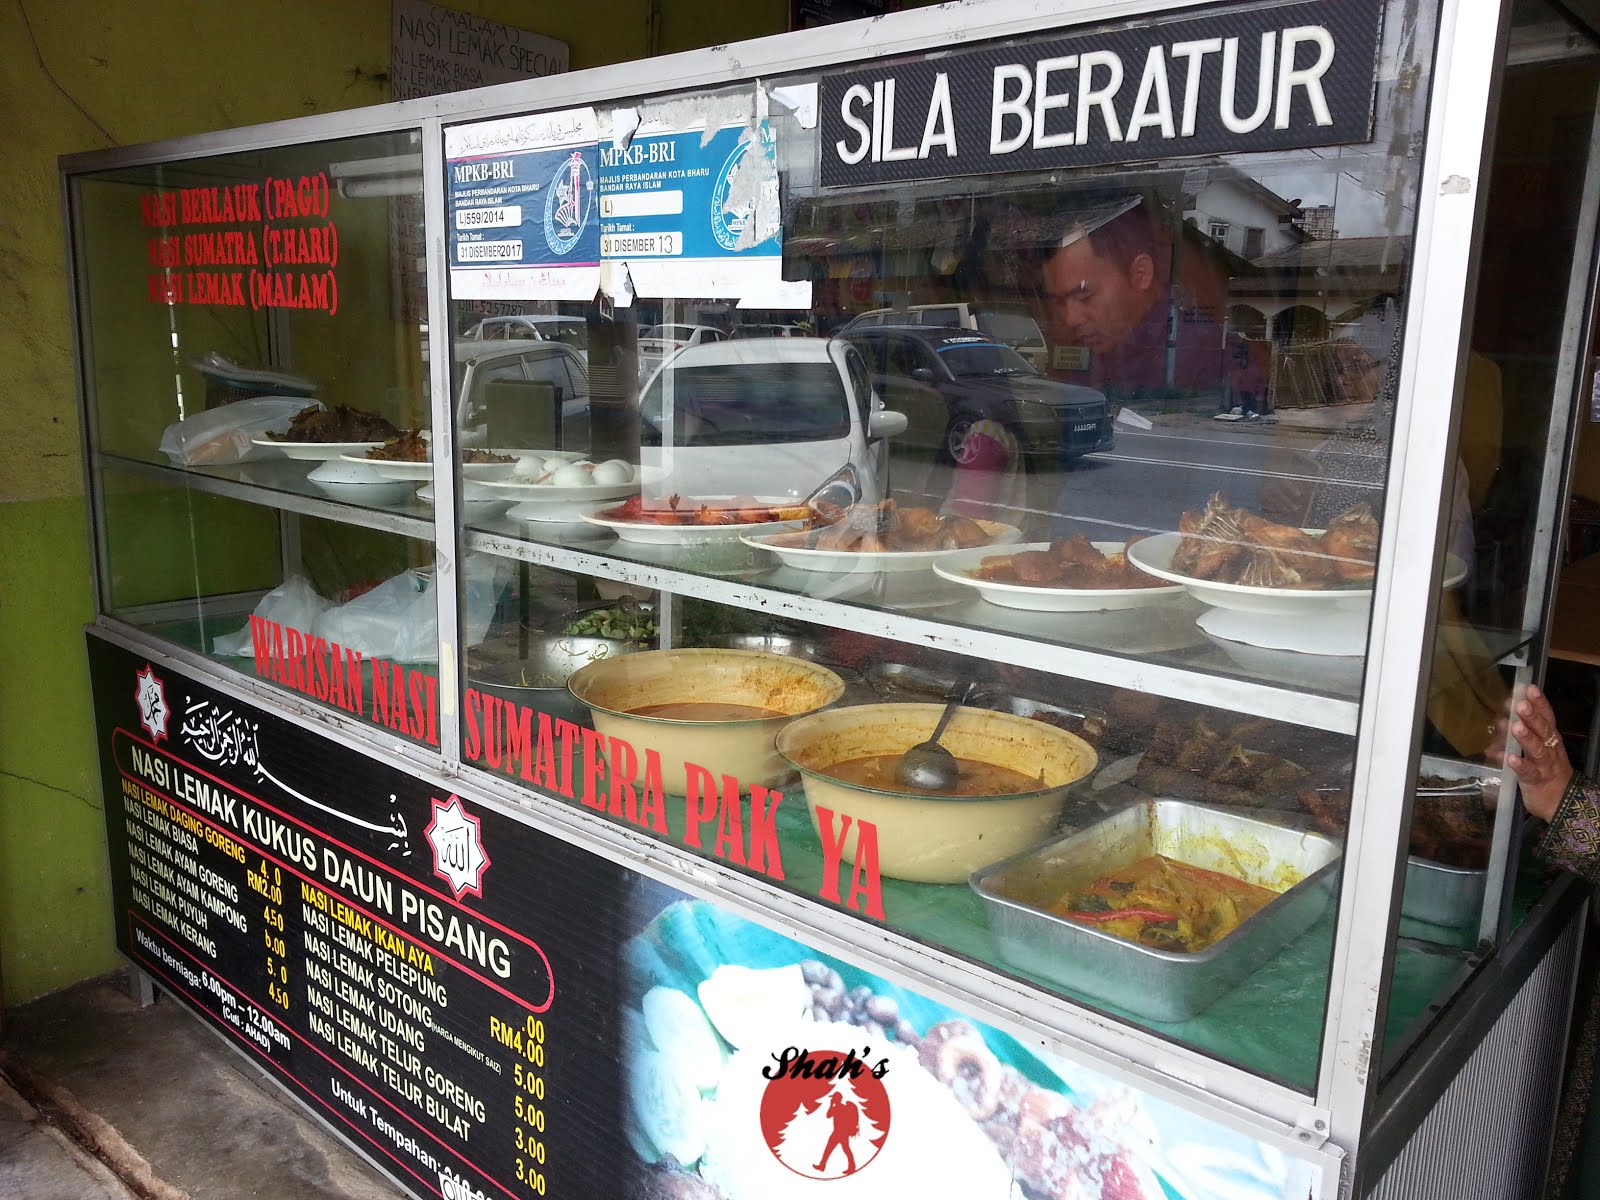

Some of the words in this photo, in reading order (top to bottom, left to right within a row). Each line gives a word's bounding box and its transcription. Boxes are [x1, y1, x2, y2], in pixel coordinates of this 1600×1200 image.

[400, 14, 440, 49] NASI
[449, 26, 506, 69] LEMAK
[410, 72, 450, 92] LEMAK
[411, 52, 450, 75] LEMAK
[454, 63, 484, 83] BIASA
[836, 72, 958, 165] SILA
[990, 25, 1336, 155] BERATUR
[454, 160, 514, 183] MPKB-BRI
[600, 141, 676, 167] MPKB-BRI
[600, 175, 623, 184] MAJLIS
[622, 171, 667, 182] PERBANDARAN
[669, 170, 685, 178] KOTA
[687, 168, 710, 177] BHARU
[140, 192, 177, 226] NASI
[180, 184, 261, 224] BERLAUK
[265, 171, 329, 220] (PAGI)
[455, 189, 472, 198] MAJLIS
[472, 186, 507, 197] PERBANDARAN
[508, 185, 521, 193] KOTA
[455, 199, 474, 207] BANDAR
[600, 183, 624, 192] BANDAR
[625, 182, 641, 190] RAYA
[643, 181, 662, 189] ISLAM
[147, 236, 180, 267] NASI
[184, 231, 259, 266] SUMATRA
[263, 221, 338, 268] (T.HARI)
[600, 223, 616, 232] Tarikh
[604, 240, 612, 253] 31
[614, 238, 655, 253] DISEMBER
[658, 235, 673, 254] 13
[461, 247, 468, 258] 31
[147, 272, 183, 304] NASI
[187, 272, 245, 306] LEMAK
[250, 268, 337, 316] (MALAM)
[248, 614, 363, 717] WARISAN
[372, 663, 439, 747] NASI
[464, 688, 668, 835] SUMATERA
[683, 761, 786, 881] PAK
[814, 803, 885, 921] YA
[122, 778, 140, 796] NASI
[141, 790, 169, 818] LEMAK
[170, 803, 204, 838] DAGING
[205, 826, 246, 864] GORENG
[124, 795, 142, 817] NASI
[143, 810, 171, 838] LEMAK
[172, 825, 199, 855] BIASA
[126, 818, 144, 839] NASI
[145, 833, 173, 862] LEMAK
[174, 850, 197, 876] AYAM
[199, 865, 239, 903] GORENG
[131, 745, 170, 790] NASI
[174, 768, 239, 829] LEMAK
[242, 804, 317, 872] KUKUS
[324, 846, 393, 915] DAUN
[402, 888, 511, 979] PISANG
[128, 841, 147, 863] NASI
[147, 856, 175, 885] LEMAK
[176, 873, 200, 899] AYAM
[200, 888, 248, 933] KAMPONG
[130, 863, 149, 885] NASI
[149, 877, 177, 906] LEMAK
[178, 895, 208, 930] PUYUH
[247, 869, 282, 905] RM2.00
[132, 886, 151, 912] NASI
[151, 900, 179, 933] LEMAK
[180, 918, 217, 959] KERANG
[264, 905, 284, 932] 4.50
[301, 881, 328, 913] NASI
[330, 898, 372, 940] LEMAK
[374, 925, 405, 960] IKAN
[408, 945, 435, 976] AYA
[302, 903, 329, 936] NASI
[331, 921, 373, 963] LEMAK
[376, 948, 448, 1008] PELEPUNG
[135, 927, 161, 958] Waktu
[162, 947, 202, 990] berniaga:
[201, 971, 237, 1009] 6.00pm
[246, 1005, 291, 1051] 12.00am
[268, 982, 289, 1009] 4.50
[304, 931, 330, 963] NASI
[333, 949, 375, 993] LEMAK
[377, 977, 432, 1029] SOTONG
[430, 1020, 454, 1042] (HARGA
[453, 1035, 485, 1063] MENGIKUT
[485, 1056, 502, 1076] SAIZ)
[305, 958, 332, 991] NASI
[334, 976, 376, 1022] LEMAK
[378, 1005, 425, 1053] UDANG
[222, 1005, 240, 1027] (Cuti
[245, 1024, 271, 1053] AHAD)
[490, 1015, 545, 1068] RM4.00
[307, 984, 334, 1018] NASI
[336, 1004, 378, 1049] LEMAK
[380, 1033, 422, 1080] TELUR
[424, 1066, 486, 1124] GORENG
[309, 1011, 335, 1045] NASI
[337, 1031, 379, 1077] LEMAK
[381, 1062, 424, 1109] TELUR
[426, 1094, 471, 1142] BULAT
[331, 1077, 368, 1120] Untuk
[514, 1063, 545, 1101] 5.00
[514, 1096, 545, 1133] 5.00
[514, 1127, 545, 1165] 3.00
[515, 1159, 546, 1196] 3.00
